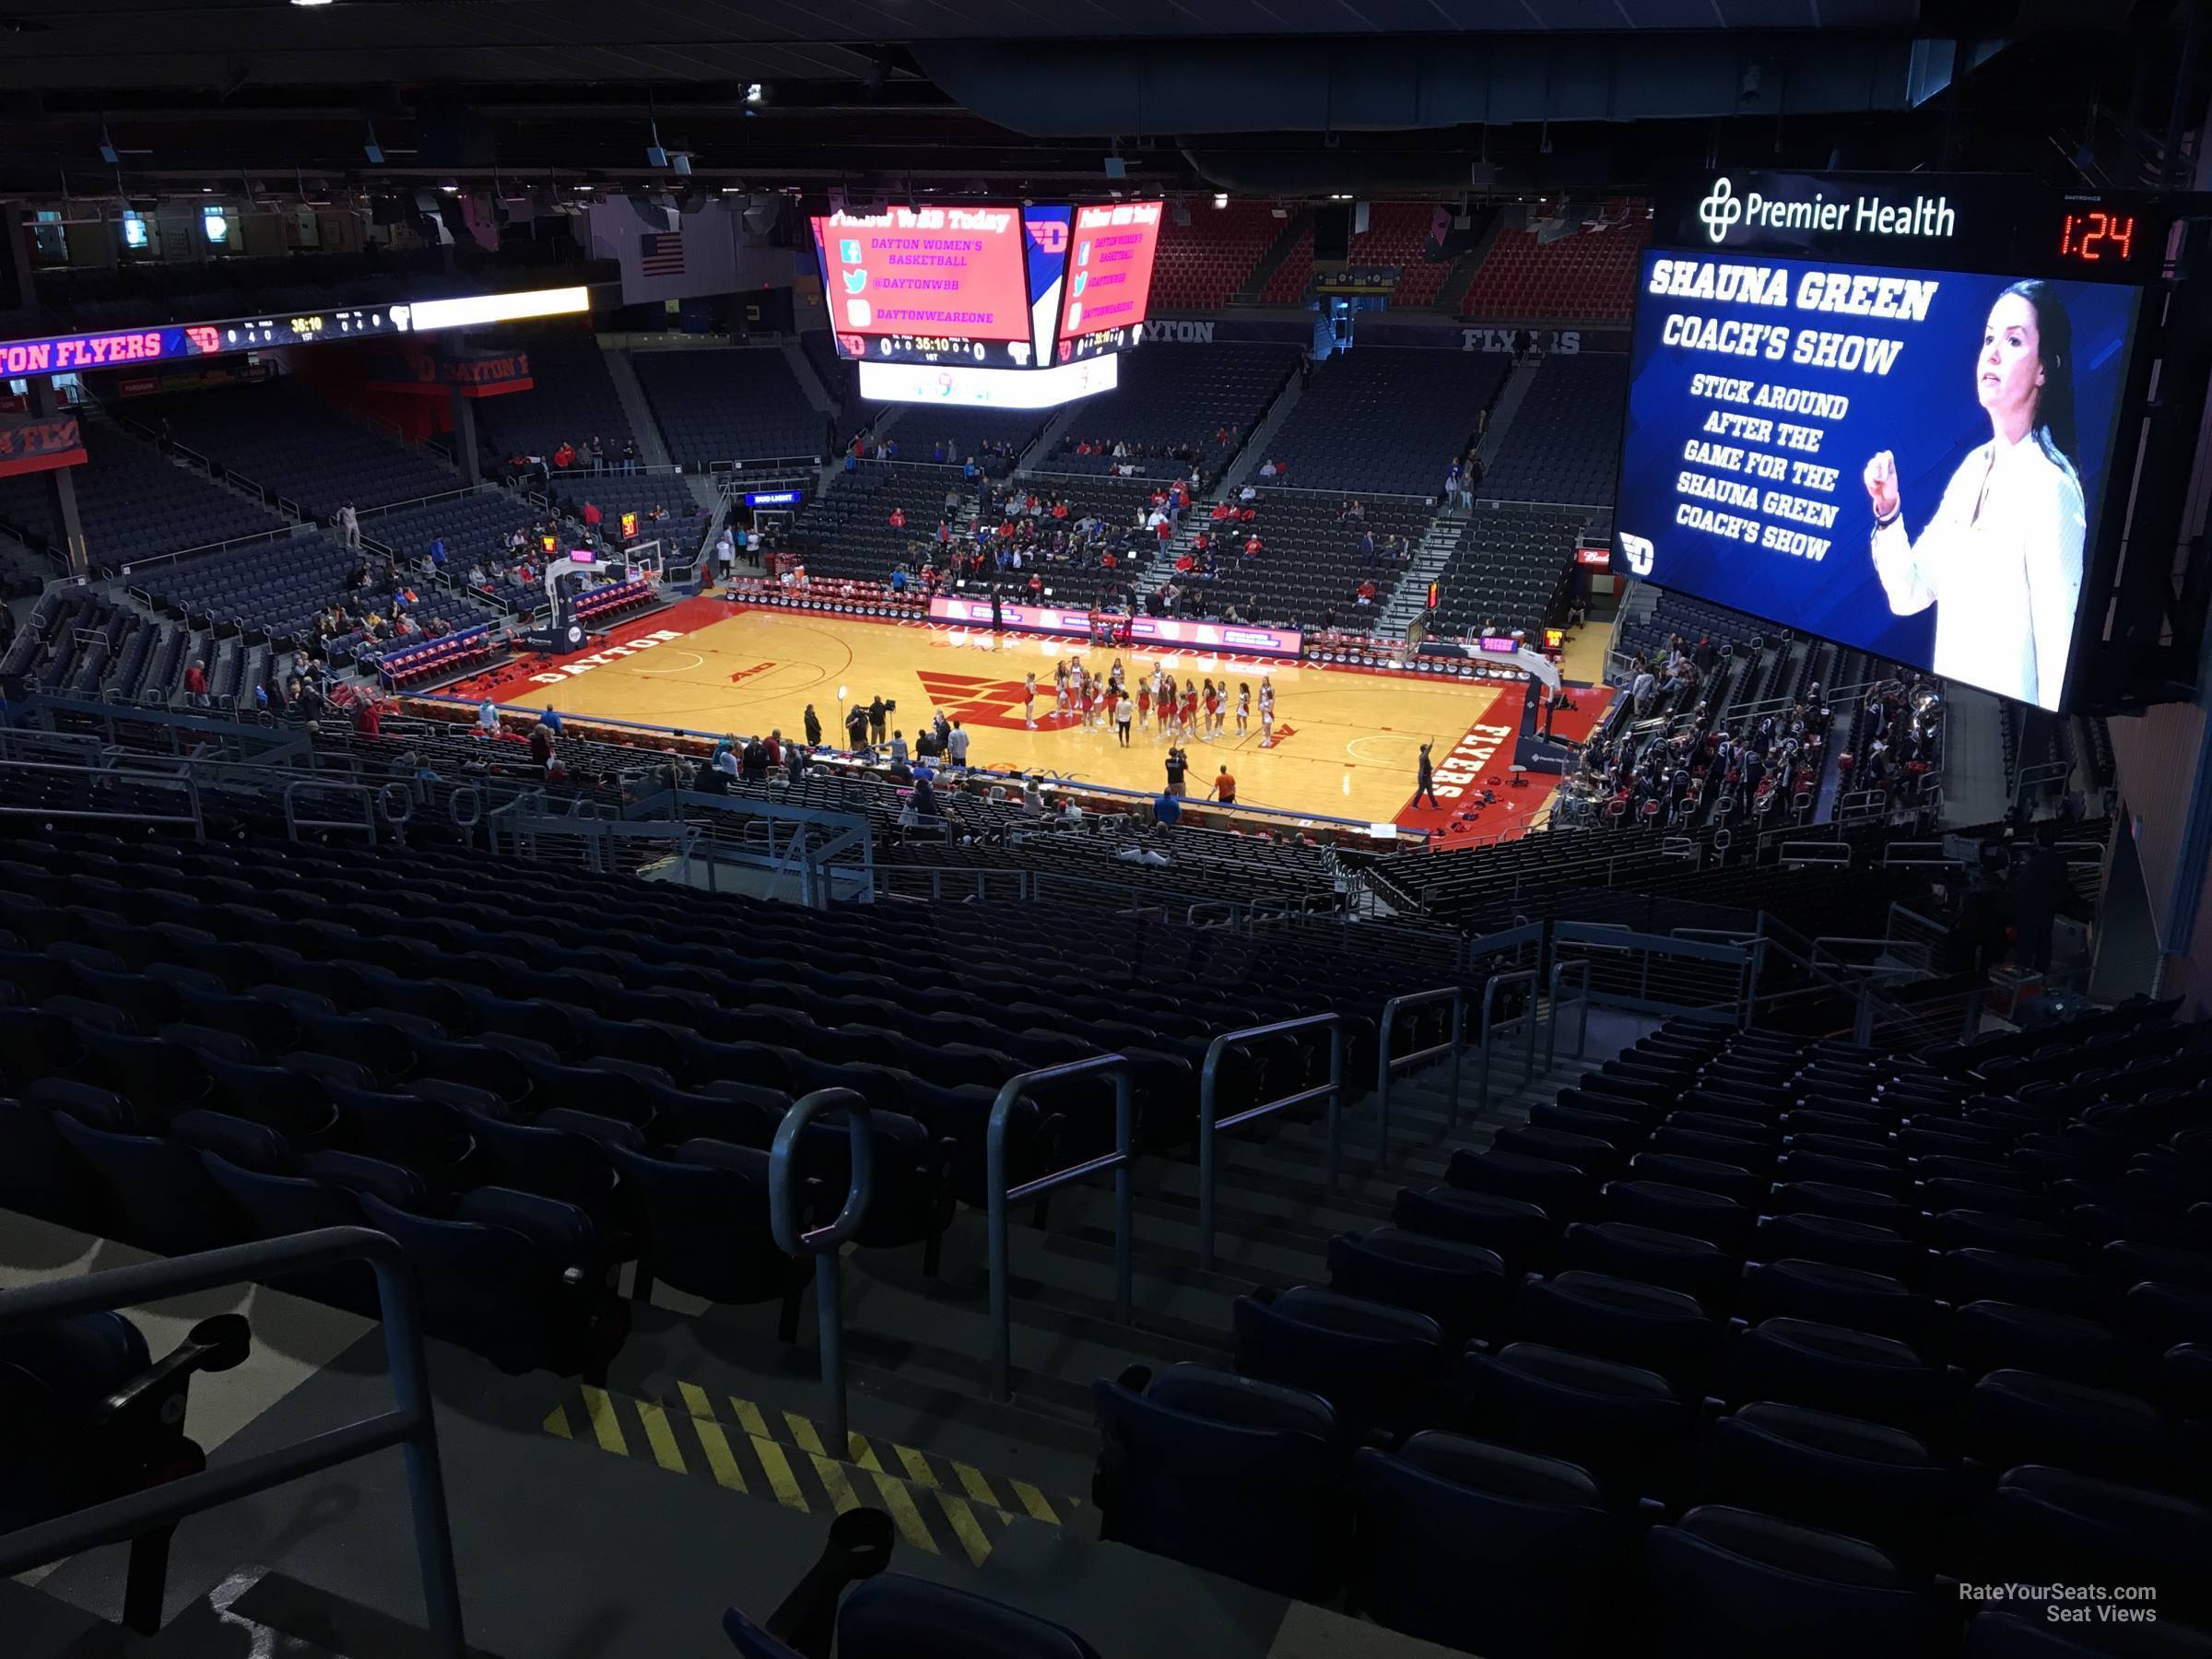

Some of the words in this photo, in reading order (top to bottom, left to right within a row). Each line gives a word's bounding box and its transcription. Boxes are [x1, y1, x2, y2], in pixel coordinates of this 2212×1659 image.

[947, 209, 1010, 233] Today
[1745, 192, 1850, 230] Premier
[1854, 196, 1955, 236] Health
[870, 238, 921, 250] DAYTON
[923, 240, 982, 252] WOMEN'S
[2063, 213, 2134, 259] 1:24
[888, 254, 967, 266] BASKETBALL
[873, 278, 959, 290] @DAYTONWBB
[1649, 259, 1788, 307] SHAUNA
[1795, 271, 1939, 321] GREEN
[290, 317, 322, 333] 35:10
[877, 309, 994, 324] DAYTONWEAREONE
[56, 333, 161, 367] FLYERS
[880, 337, 892, 356] 0
[915, 336, 949, 351] 35:10
[973, 342, 985, 360] 0
[1663, 313, 1790, 360] COACH'S
[1793, 329, 1904, 376] SHOW
[1690, 373, 1754, 404] STICK
[1753, 383, 1849, 420] AROUND
[1703, 410, 1772, 443] AFTER
[1777, 422, 1824, 453] THE
[1684, 440, 1744, 471] GAME
[1744, 451, 1788, 480] FOR
[1792, 460, 1840, 492] THE
[1677, 471, 1759, 510] SHAUNA
[1762, 490, 1840, 529] GREEN
[1676, 503, 1760, 544] COACH'S
[1761, 526, 1831, 562] SHOW
[528, 629, 684, 684] DAYTON
[1169, 648, 1331, 671] DAYTON
[1021, 767, 1091, 782] PNC
[1422, 724, 1512, 798] FLYERS
